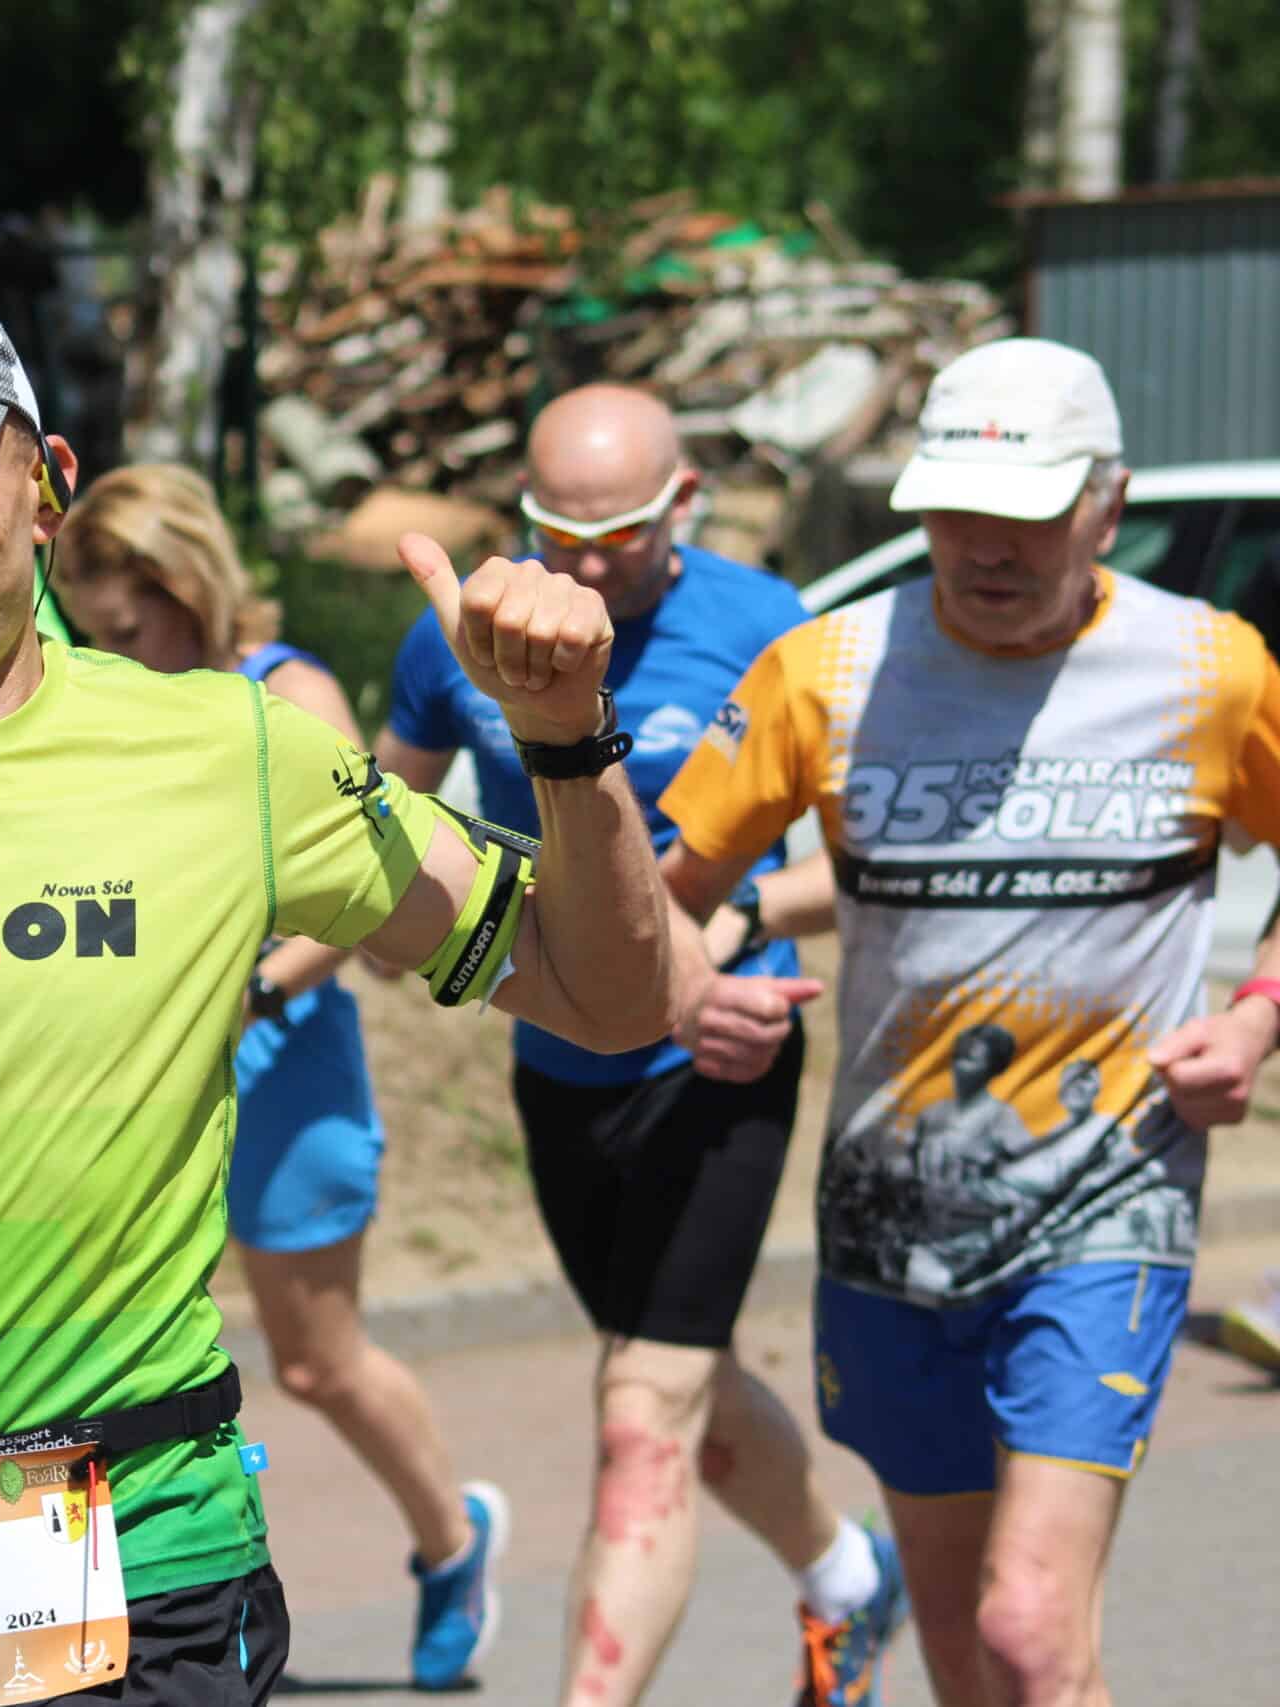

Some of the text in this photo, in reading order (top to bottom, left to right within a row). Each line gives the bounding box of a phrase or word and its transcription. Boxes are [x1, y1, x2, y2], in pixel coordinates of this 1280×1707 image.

[841, 762, 958, 842] 35
[40, 879, 134, 898] Nowa Sól
[927, 868, 982, 897] Sól
[450, 920, 496, 994] OUTHORN
[5, 1608, 57, 1630] 2024
